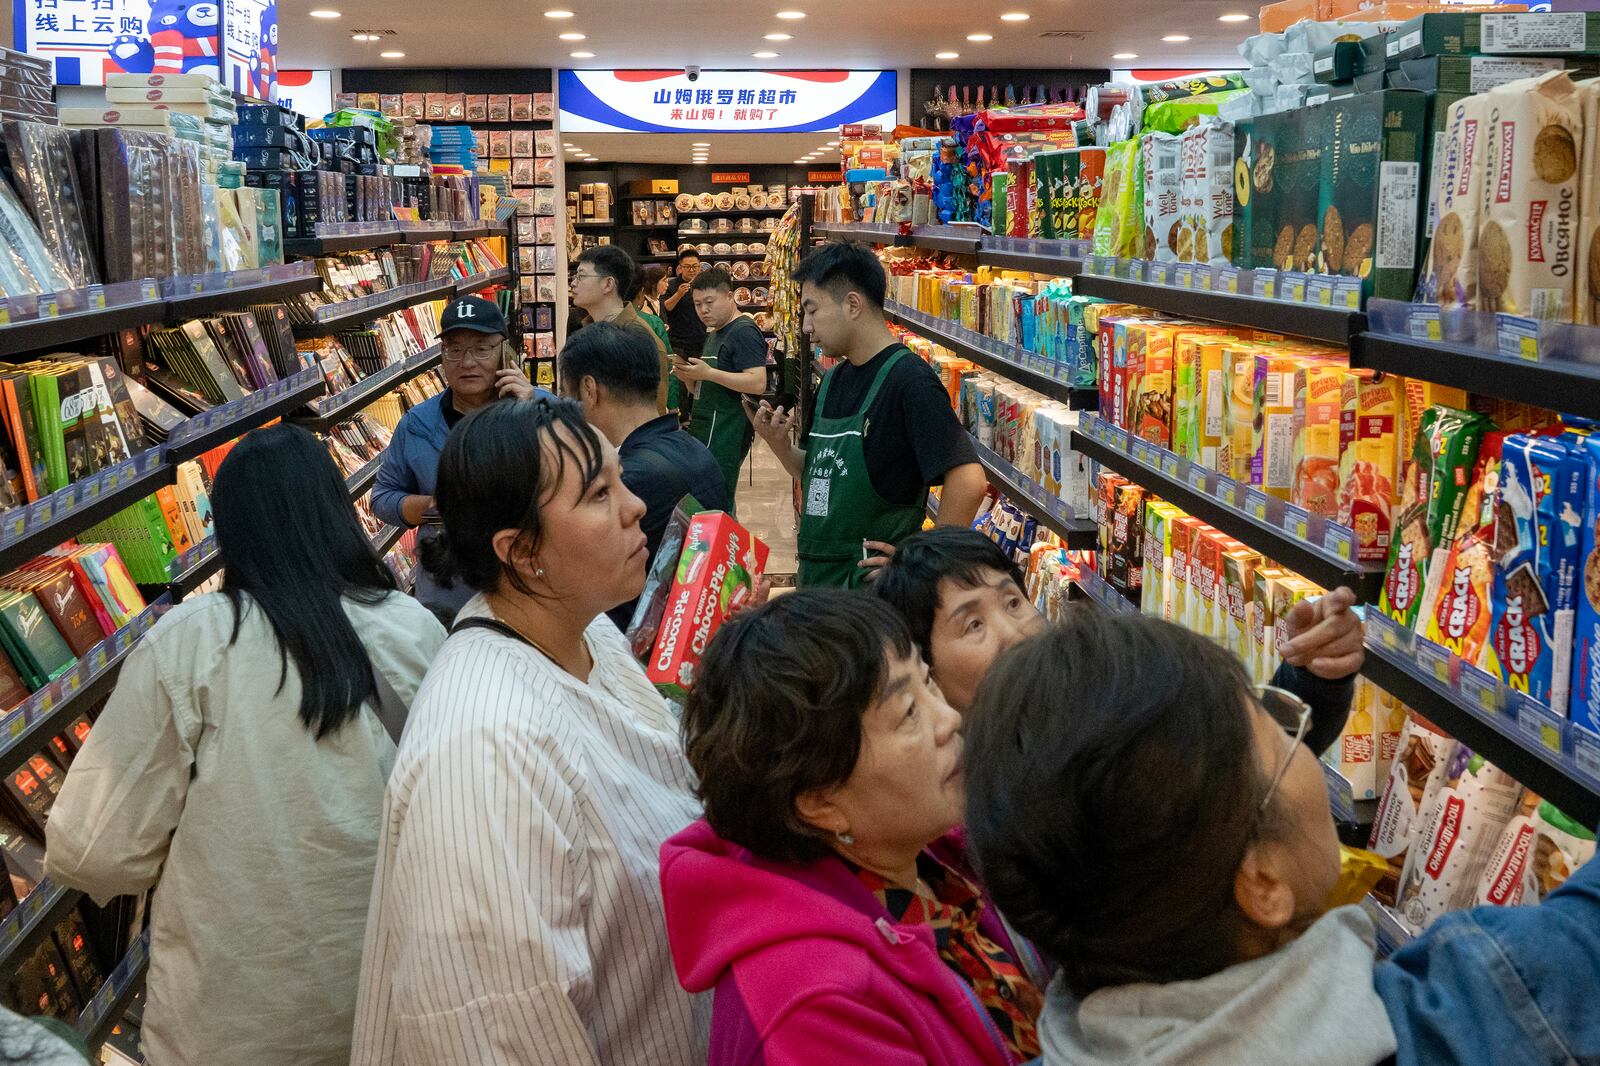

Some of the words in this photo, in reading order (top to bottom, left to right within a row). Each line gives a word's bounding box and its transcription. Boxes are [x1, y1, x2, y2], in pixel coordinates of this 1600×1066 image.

[36, 13, 143, 35] 线上云购
[653, 88, 798, 105] 山姆俄罗斯超市
[670, 108, 779, 121] 来山姆！就购了
[1460, 121, 1477, 194] КУХМАСТЕР
[1499, 124, 1515, 201] КУХМАСТЕР
[1159, 193, 1169, 217] Well
[1211, 194, 1223, 219] Well
[1530, 203, 1544, 262] КУХМАСТЕР
[1551, 187, 1574, 277] Овсяное
[688, 521, 703, 551] Арбуз
[726, 531, 740, 571] Арбуз
[1395, 542, 1412, 609] CRACK
[1448, 566, 1472, 638] CRACK
[1505, 595, 1526, 673] CRACK
[1345, 735, 1354, 762] MEGA
[1353, 737, 1362, 761] LINE
[1361, 734, 1371, 761] CHIPS
[1382, 733, 1391, 760] MEGA
[1379, 792, 1398, 844] ЛЮБИМОЕ
[1386, 800, 1404, 845] ОВСЯНОЕ
[1429, 803, 1460, 871] ПОСИДЕЛКИНО
[1492, 831, 1532, 900] ПОСИДЕЛКИНО
